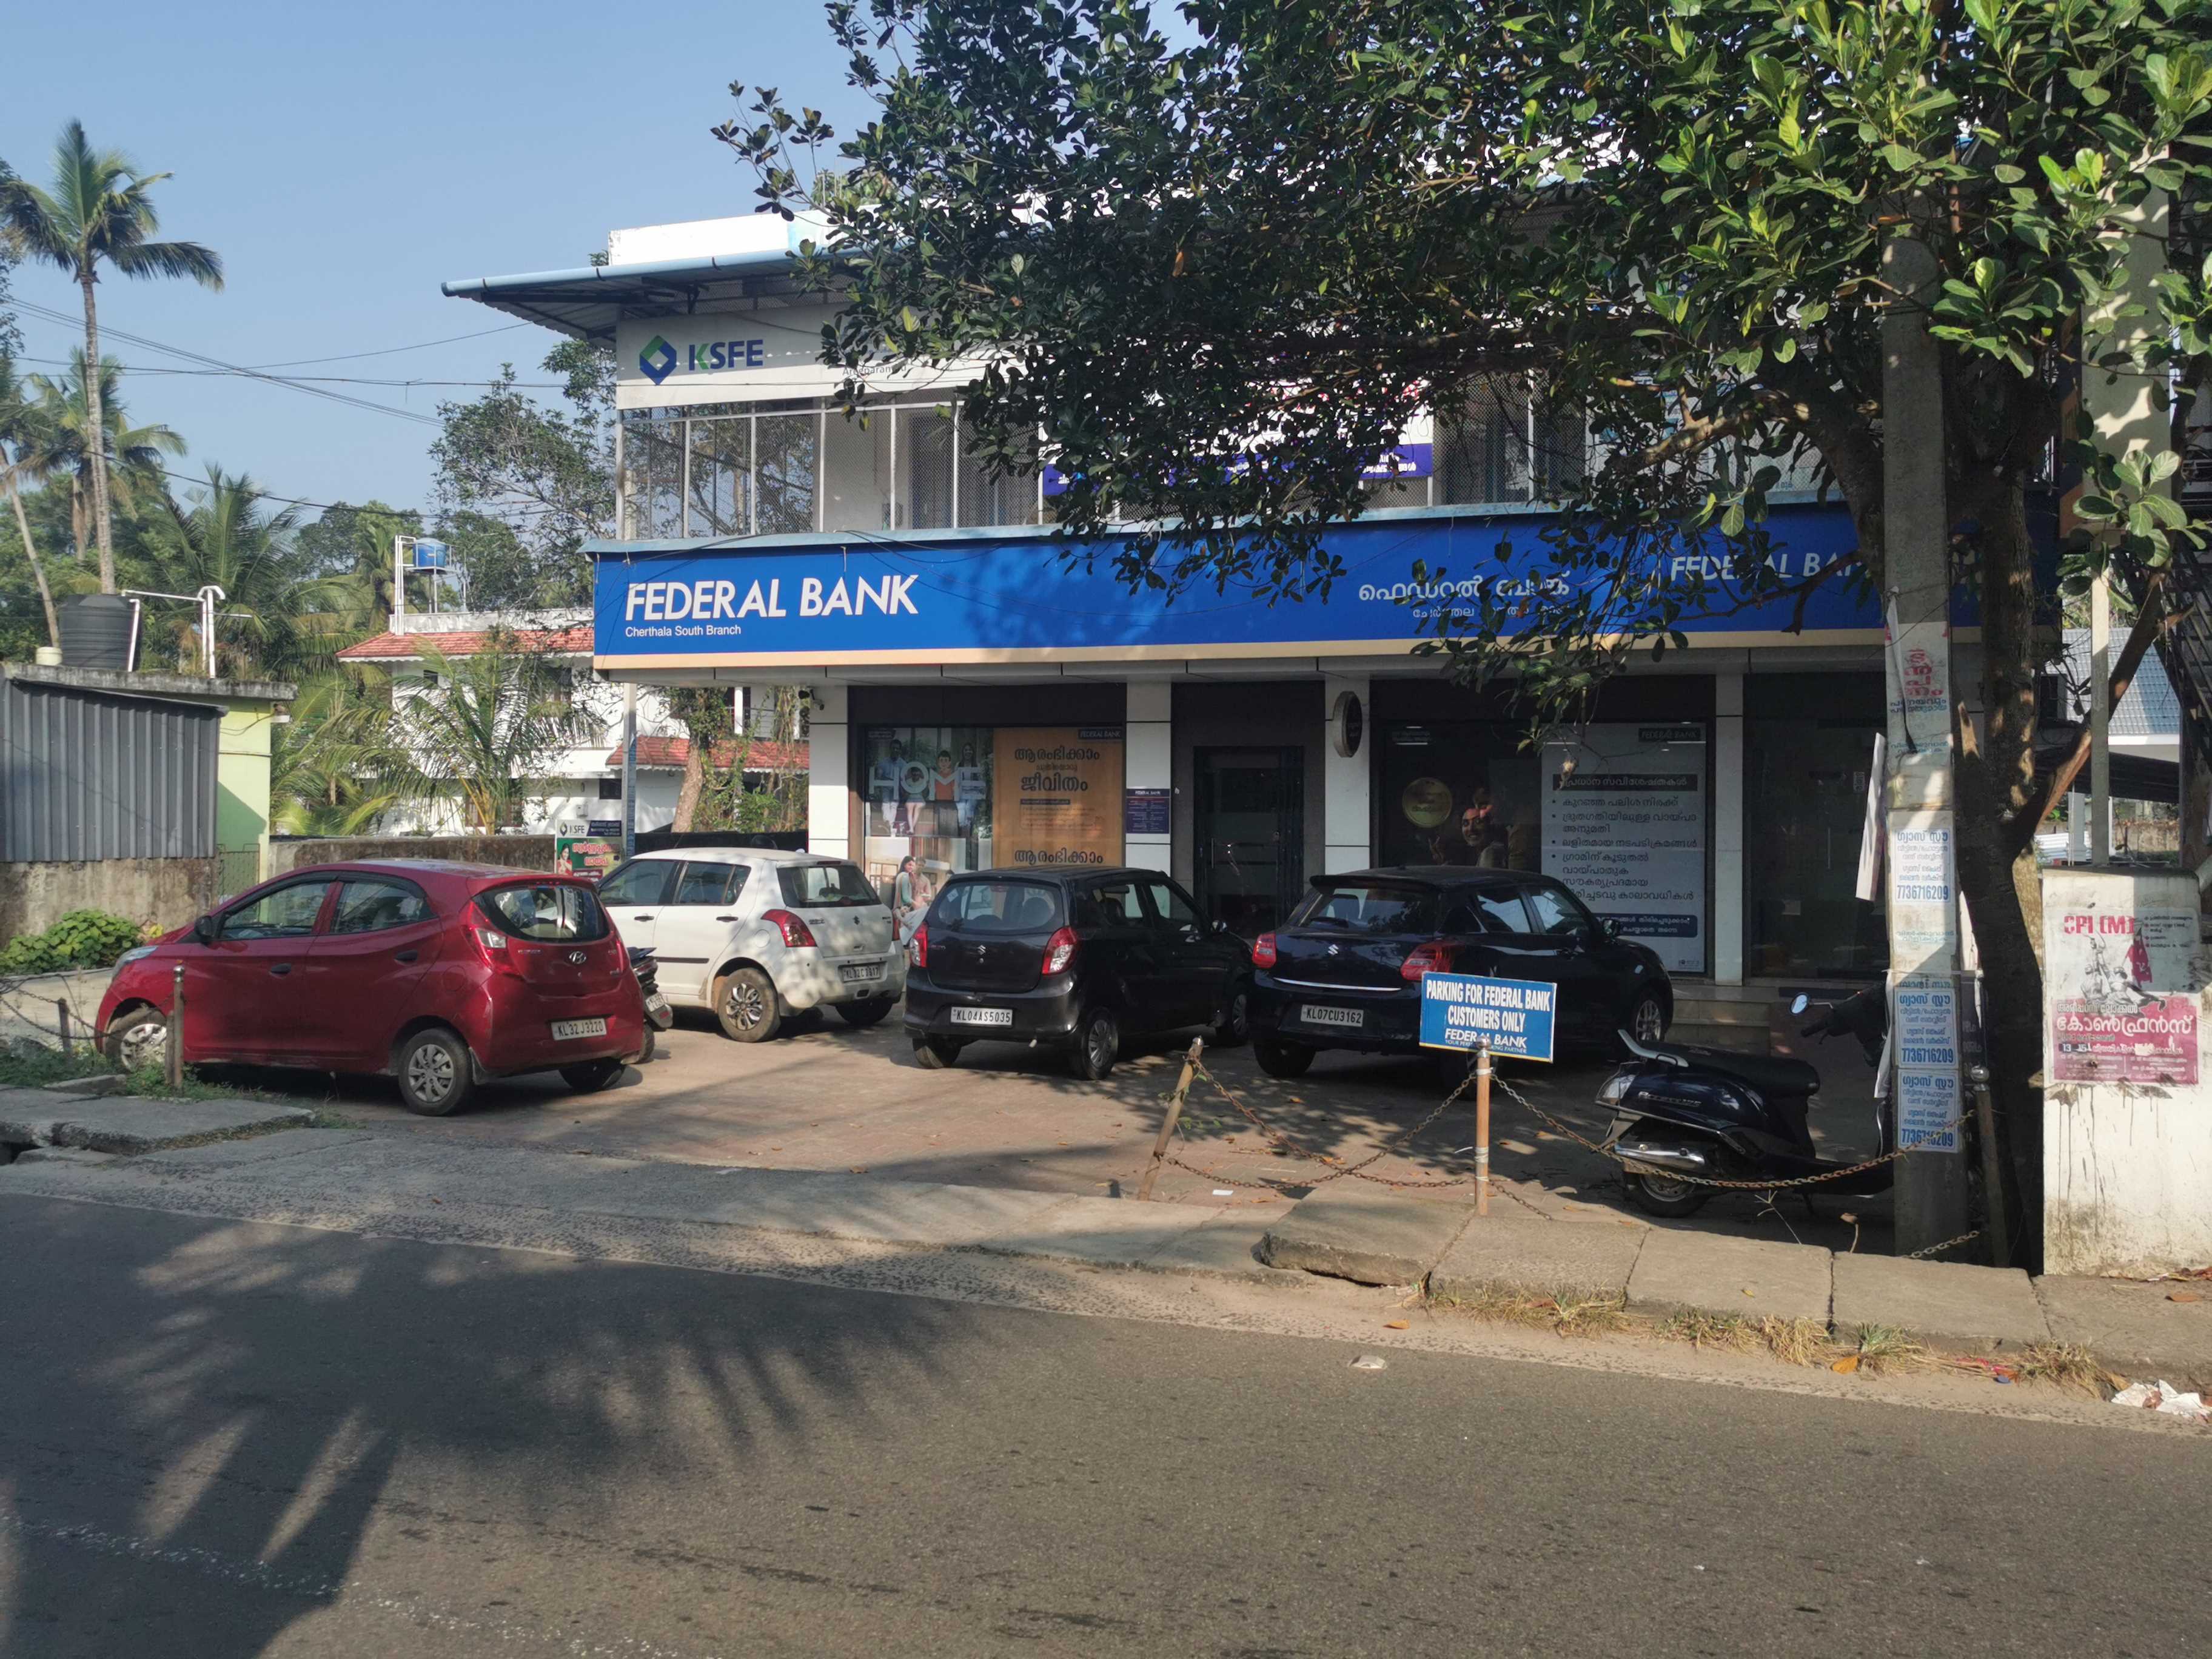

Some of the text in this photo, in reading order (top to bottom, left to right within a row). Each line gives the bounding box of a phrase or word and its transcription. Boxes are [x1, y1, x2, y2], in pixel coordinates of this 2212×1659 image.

[689, 340, 763, 371] KSFE
[1671, 553, 1792, 581] FEDEAL
[625, 575, 919, 621] FEDERAL BANK
[625, 625, 741, 637] Cherthala South Branch
[1014, 745, 1100, 762] ആരംഭിക്കാം
[868, 761, 986, 801] HOME
[1021, 772, 1088, 791] ജീവിതം
[1014, 847, 1103, 865] ആരംഭിക്കാം
[1897, 885, 1949, 900] 7736716209
[2064, 916, 2093, 934] CPI
[1426, 980, 1550, 1011] PARKING FOR FEDERAL BANK
[1900, 993, 1929, 1007] ഗ്യാസ്
[956, 1010, 1011, 1024] KL04AS5035
[1306, 1007, 1362, 1024] KL07CU3162
[1447, 1005, 1526, 1033] CUSTOMERS ONLY
[1494, 1034, 1527, 1048] BANK
[1902, 1048, 1954, 1063] 7736716209
[1903, 1075, 1932, 1088] ഗ്യാസ്
